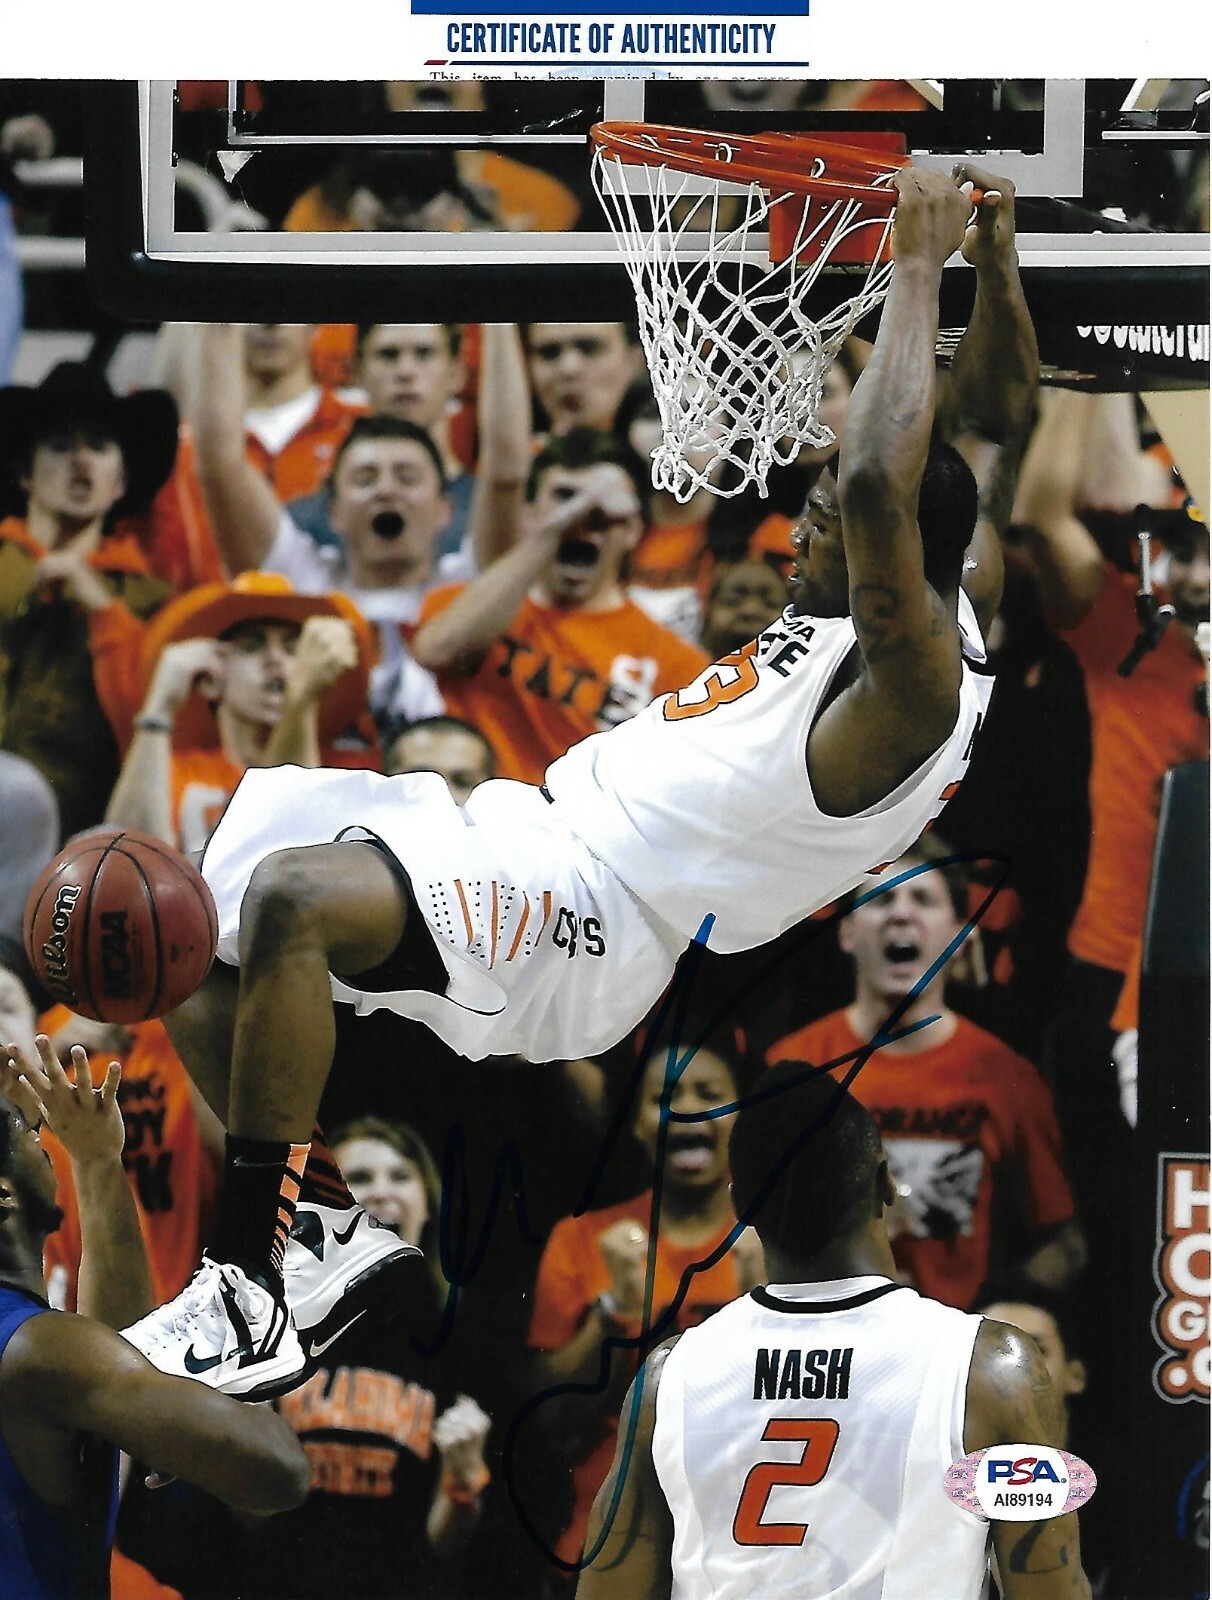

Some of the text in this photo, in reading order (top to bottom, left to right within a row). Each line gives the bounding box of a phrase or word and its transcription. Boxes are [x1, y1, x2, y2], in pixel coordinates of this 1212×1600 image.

[447, 22, 776, 54] CERTIFICATE OF AUTHENTICITY
[753, 1348, 854, 1400] NASH
[733, 1418, 840, 1546] 2
[994, 1493, 1053, 1507] AI89194
